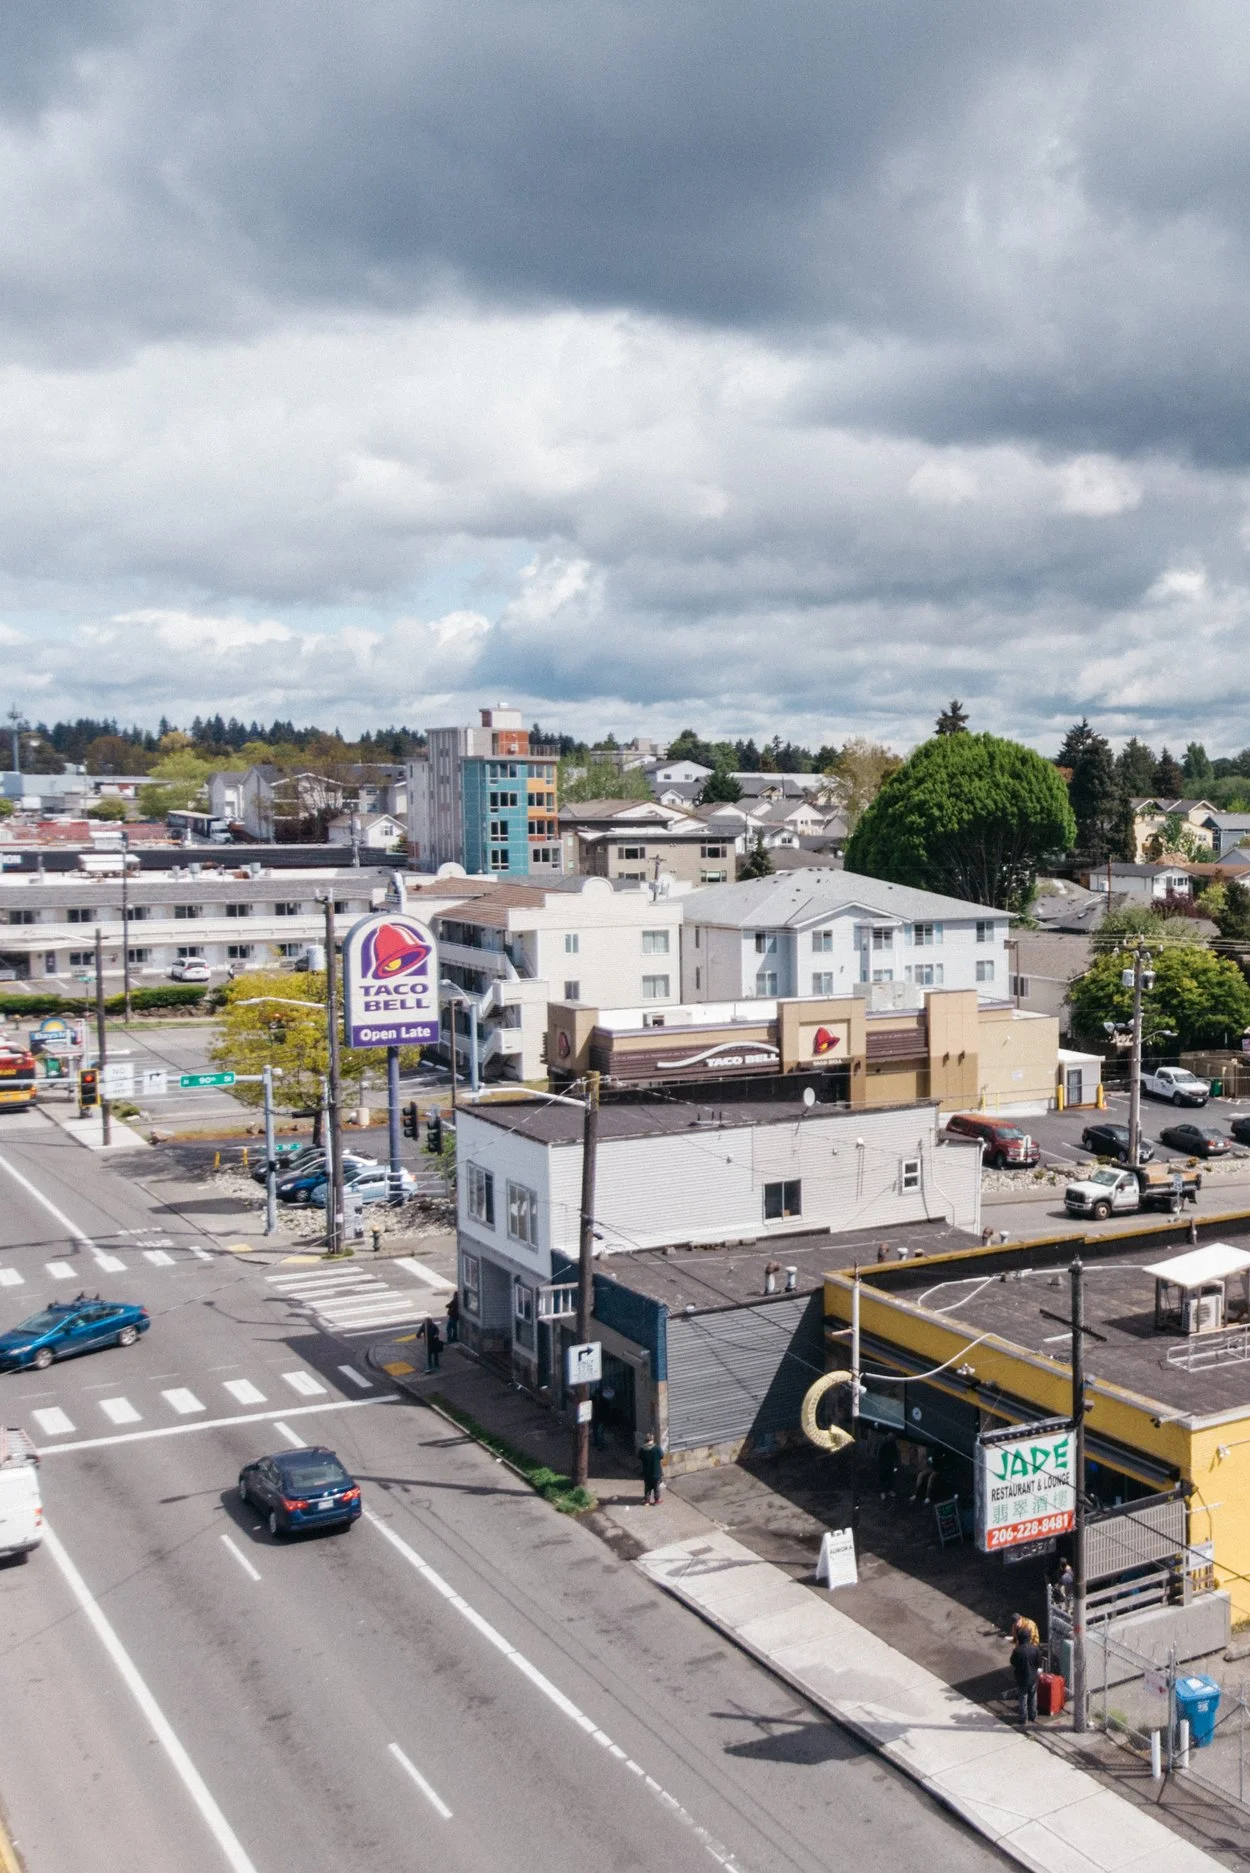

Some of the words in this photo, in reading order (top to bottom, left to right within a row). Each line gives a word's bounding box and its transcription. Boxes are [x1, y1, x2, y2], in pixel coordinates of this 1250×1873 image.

[359, 983, 429, 997] TACO
[364, 998, 430, 1012] BELL
[360, 1028, 397, 1041] Open
[401, 1026, 431, 1038] Late
[706, 1056, 743, 1067] TACO
[745, 1053, 779, 1064] BELL
[993, 1439, 1069, 1480] JADE
[991, 1480, 1035, 1502] RESTAURANT
[1037, 1480, 1042, 1491] &
[1043, 1472, 1070, 1490] LOUNGE
[991, 1514, 1069, 1545] 206-228-8481
